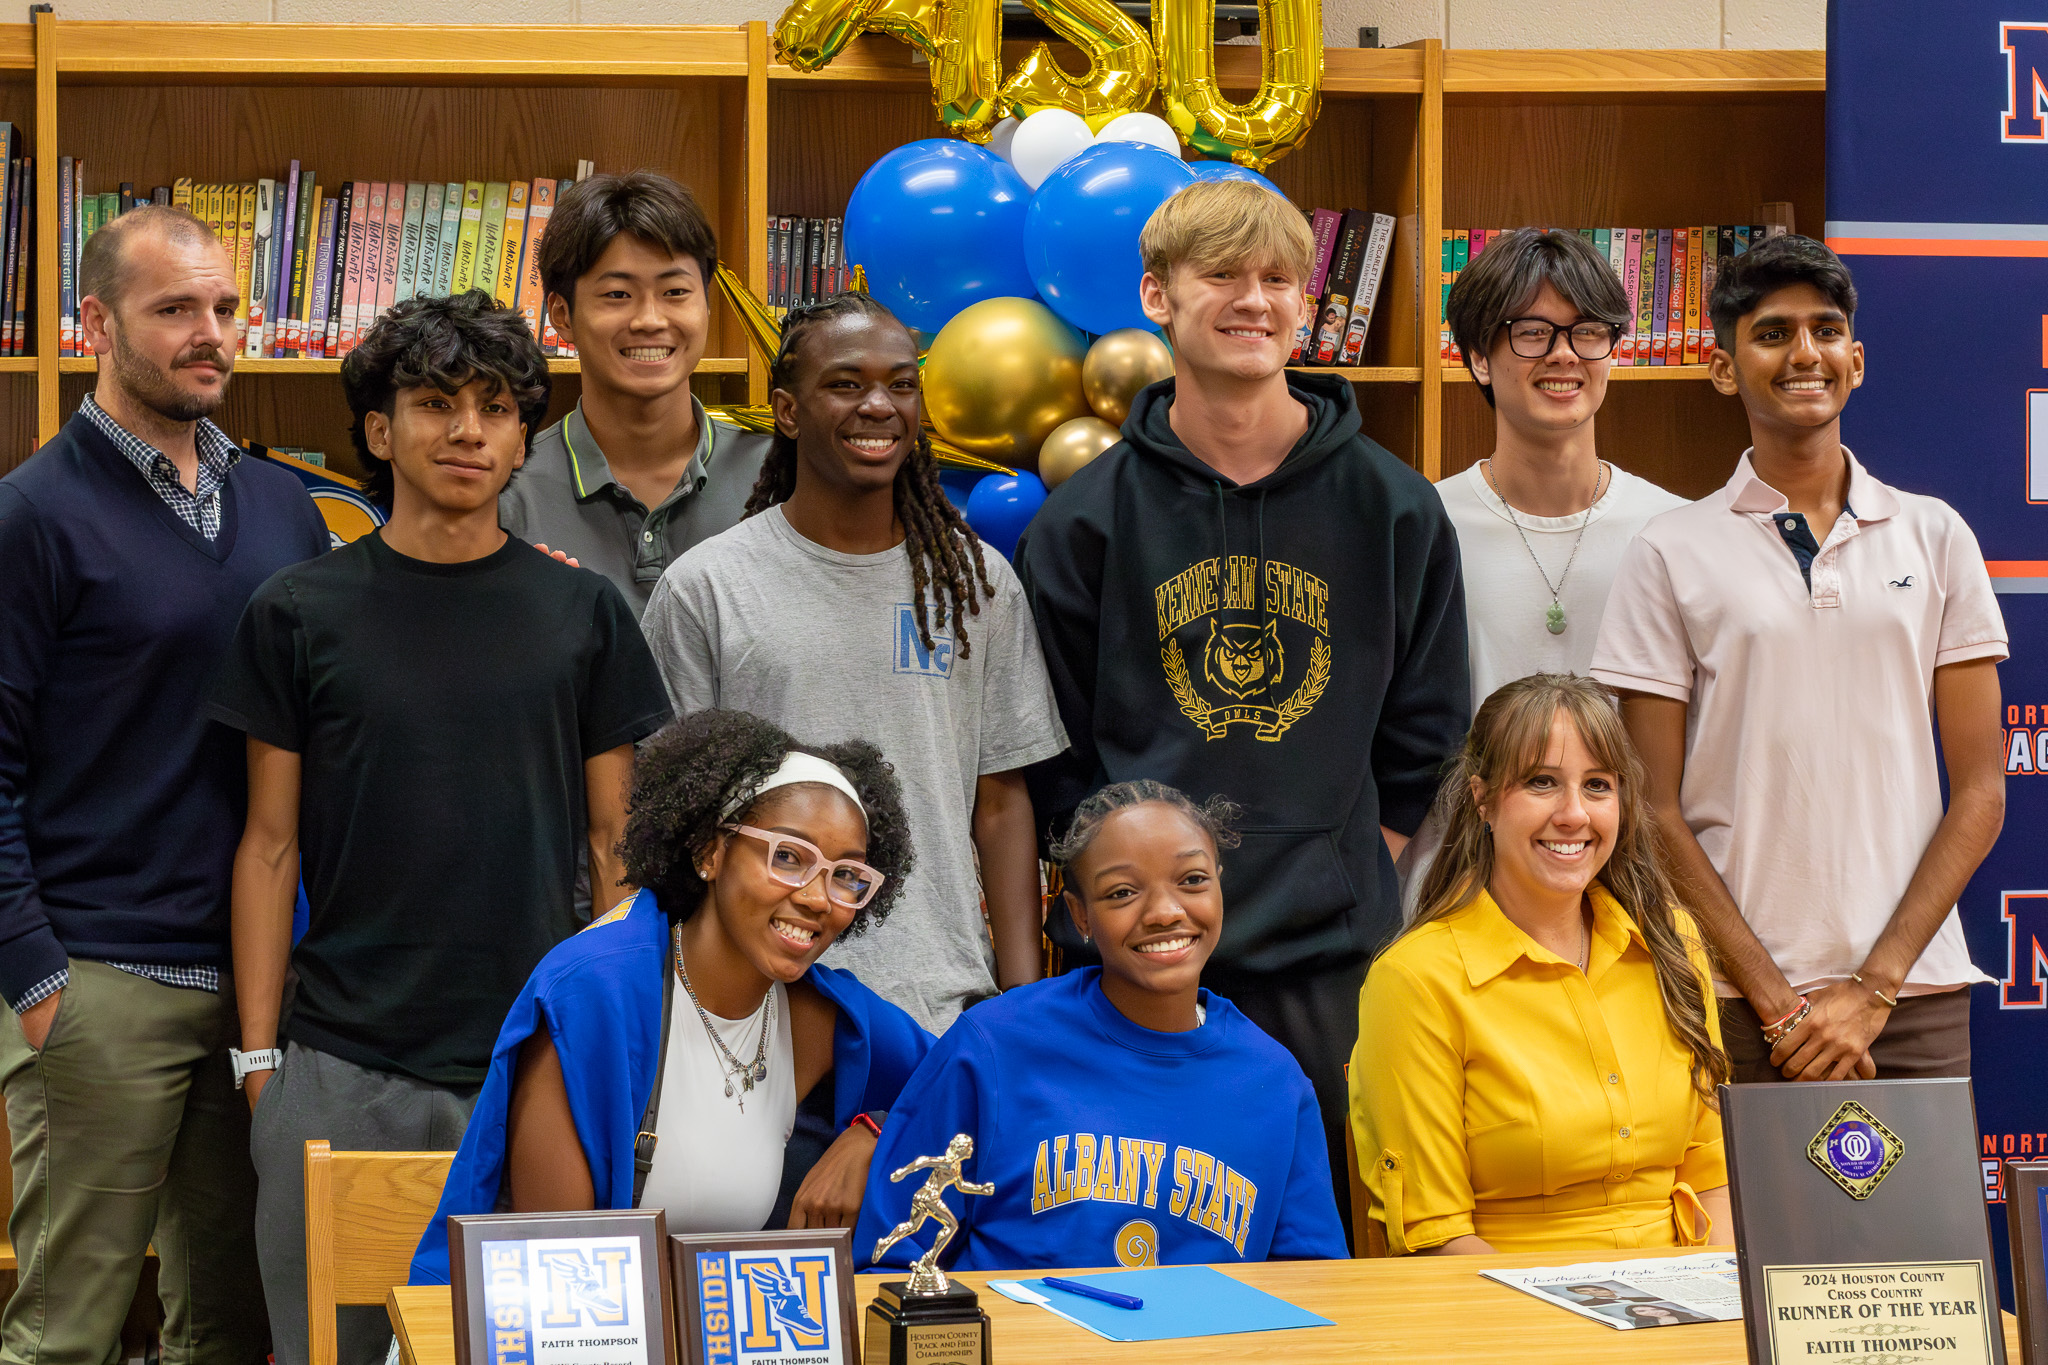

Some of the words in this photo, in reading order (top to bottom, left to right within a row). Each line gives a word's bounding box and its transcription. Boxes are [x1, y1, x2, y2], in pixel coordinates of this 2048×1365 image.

[1320, 216, 1334, 246] ROMEO
[1345, 229, 1354, 250] BRAM
[1366, 228, 1380, 263] NATHANIEL
[1378, 228, 1389, 242] THE
[62, 242, 71, 265] FISH
[238, 236, 251, 271] DANGER
[257, 238, 265, 255] JUST
[295, 249, 304, 268] AFTER
[316, 239, 331, 281] TURNING
[336, 238, 345, 268] PROJECT
[348, 221, 364, 283] HEARTSTOPPER
[366, 220, 382, 282] HEARTSTOPPER
[384, 222, 400, 285] HEARTSTOPPER
[402, 222, 419, 284] HEARTSTOPPER
[421, 222, 438, 284] HEARTSTOPPER
[481, 222, 499, 284] HEARTSTOPPER
[1315, 247, 1326, 263] AND
[1345, 225, 1366, 284] DRACULA
[1370, 244, 1385, 277] SCARLET
[294, 269, 302, 282] THE
[438, 241, 453, 291] HEARTSTOPPER
[458, 239, 473, 290] HEARTSTOPPER
[502, 239, 517, 289] HEARTSTOPPER
[1309, 264, 1321, 293] JULIET
[1337, 251, 1349, 280] STOKER
[63, 267, 71, 293] GIRL
[255, 264, 263, 297] HAPPENS
[292, 283, 301, 298] RAIN
[1357, 264, 1371, 301] HAWTHORNE
[1363, 279, 1377, 306] LETTER
[1656, 259, 1665, 309] CLASSROOM
[1672, 258, 1682, 308] CLASSROOM
[1689, 255, 1697, 305] CLASSROOM
[313, 283, 326, 316] TWELVE
[780, 296, 784, 305] 1
[793, 298, 799, 307] 2
[1154, 555, 1257, 642] KENNESAW
[1265, 560, 1329, 638] STATE
[1224, 710, 1262, 721] OWLS
[2007, 705, 2048, 725] ORT
[1983, 1134, 2048, 1153] NORT
[1030, 1132, 1166, 1215] ALBANY
[1168, 1145, 1258, 1258] STATE
[1608, 1268, 1656, 1278] High
[1663, 1262, 1720, 1274] School
[1802, 1273, 1837, 1286] 2024
[1841, 1273, 1896, 1285] HOUSTON
[1900, 1271, 1945, 1283] COUNTY
[538, 1246, 632, 1329] N
[1827, 1289, 1867, 1300] CROSS
[1870, 1288, 1923, 1299] COUNTRY
[735, 1255, 831, 1353] N
[1777, 1304, 1853, 1321] RUNNER
[1858, 1304, 1882, 1318] OF
[1887, 1302, 1924, 1317] THE
[1929, 1300, 1978, 1316] YEAR
[541, 1340, 574, 1349] FAITH
[578, 1337, 639, 1347] THOMPSON
[910, 1332, 945, 1341] HOUSTON
[946, 1331, 979, 1340] COUNTY
[913, 1342, 937, 1350] TRACK
[1806, 1340, 1856, 1354] FAITH
[1861, 1336, 1957, 1353] THOMPSON
[780, 1356, 829, 1365] THOMPSON
[915, 1350, 973, 1358] CHAMPIONSHIPS
